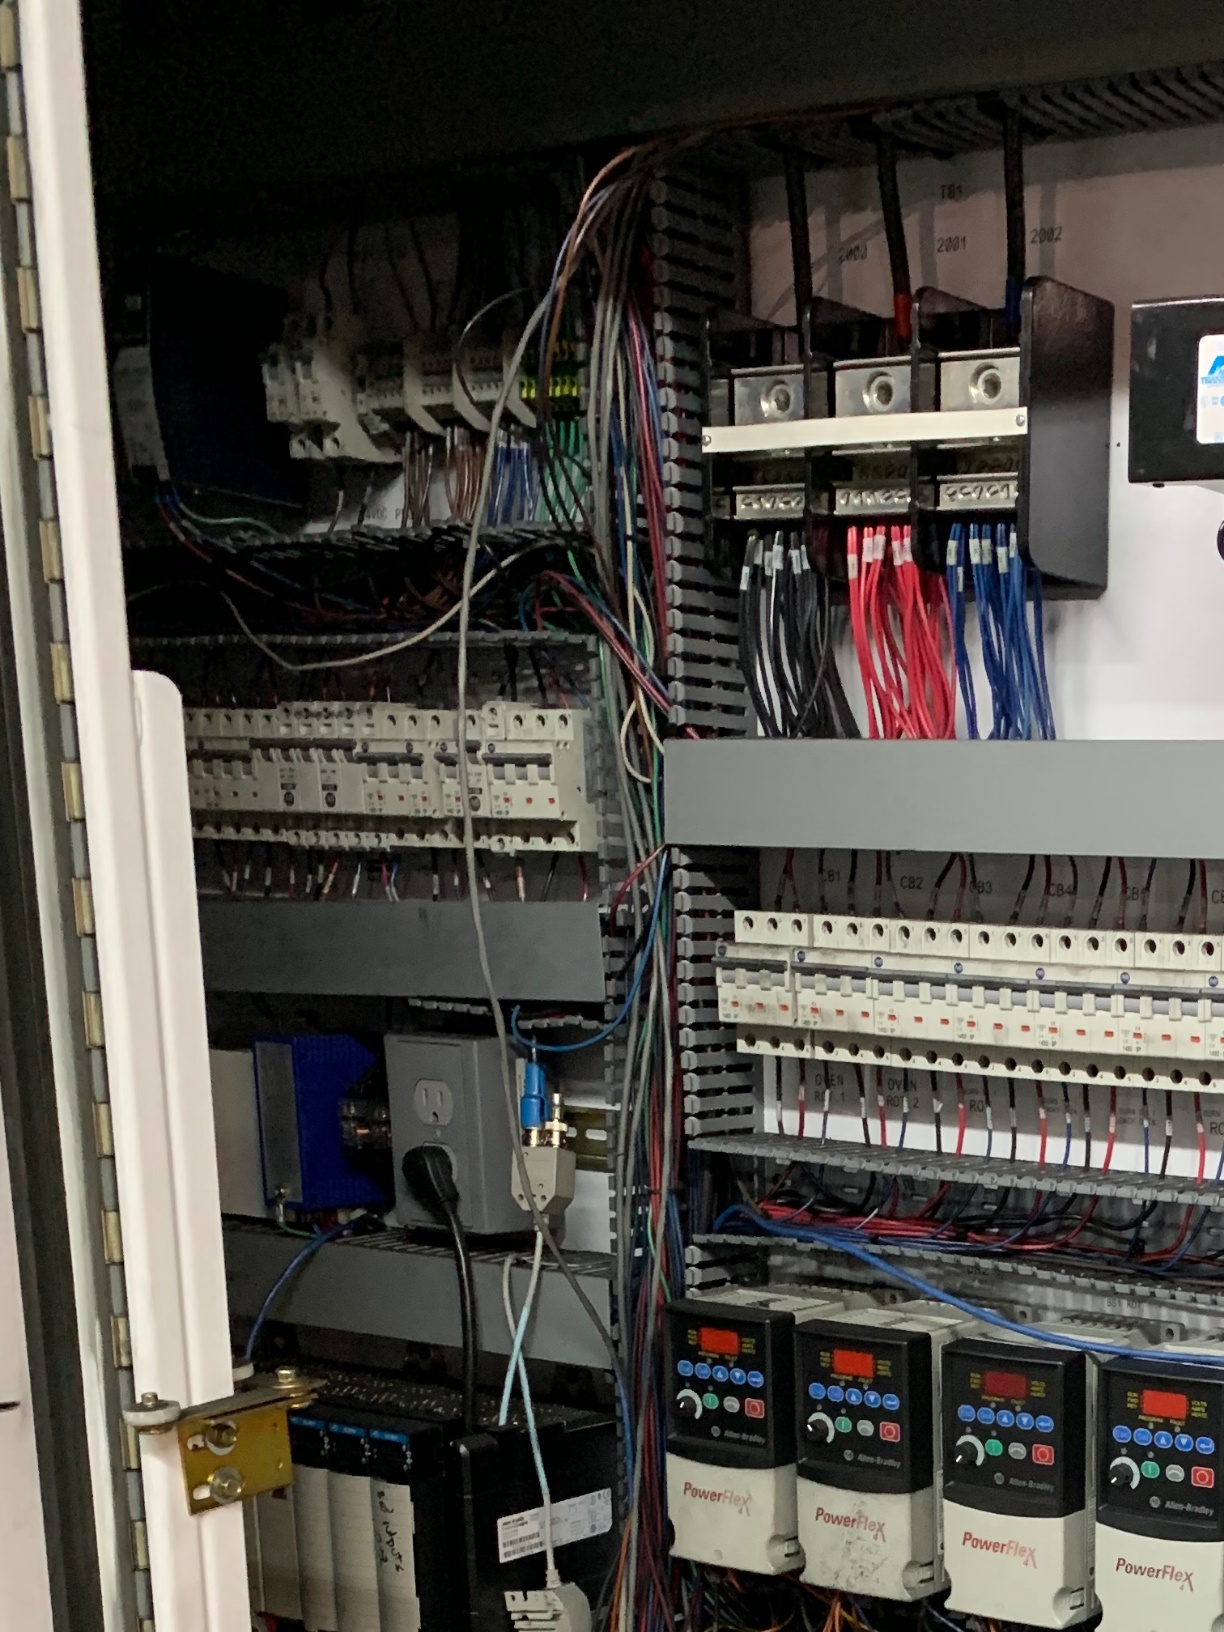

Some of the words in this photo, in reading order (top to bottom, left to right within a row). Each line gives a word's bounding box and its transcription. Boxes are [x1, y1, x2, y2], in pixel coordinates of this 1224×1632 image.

[936, 235, 967, 253] 2001
[1029, 226, 1063, 245] 2002
[900, 875, 923, 890] CB2
[815, 1073, 844, 1087] OEN
[888, 1078, 917, 1092] OVN
[683, 1481, 752, 1517] PowerFlex
[815, 1506, 887, 1543] PowerFlex
[962, 1531, 1037, 1569] PowerFlex
[1115, 1557, 1194, 1592] PowerFlex
